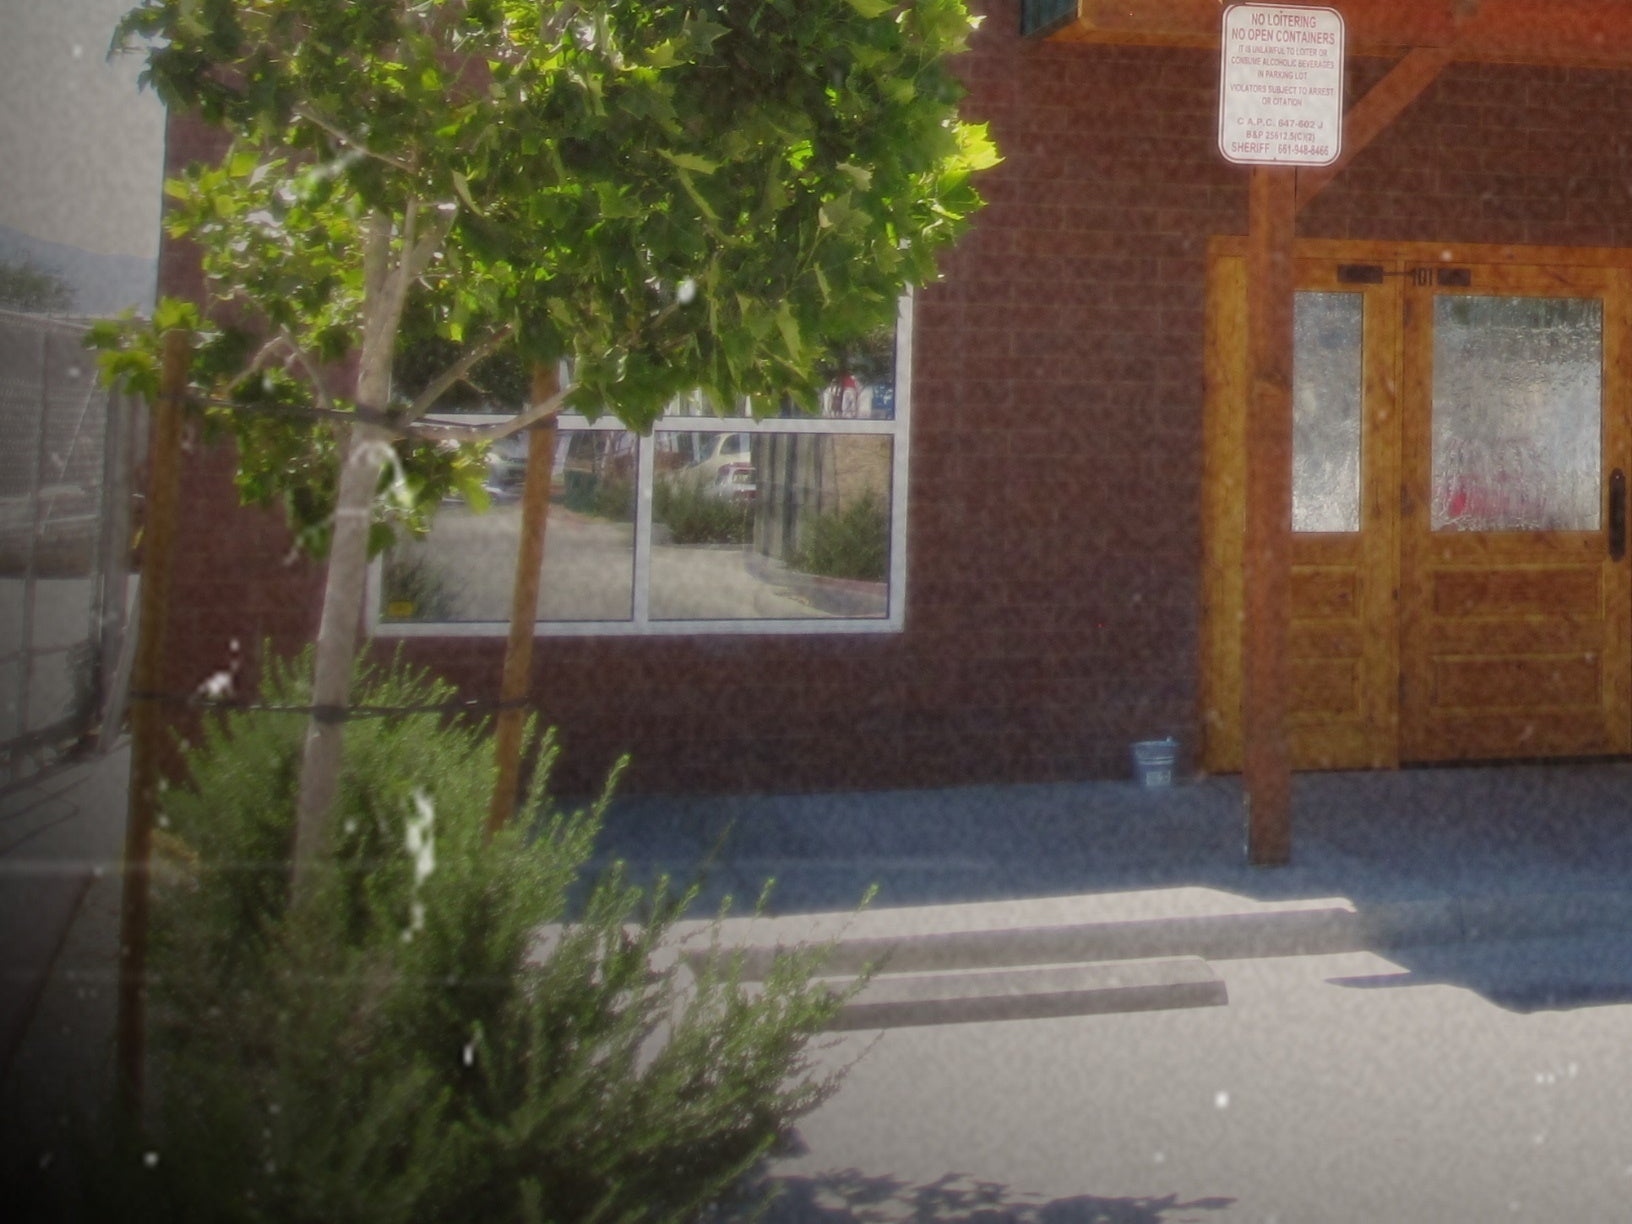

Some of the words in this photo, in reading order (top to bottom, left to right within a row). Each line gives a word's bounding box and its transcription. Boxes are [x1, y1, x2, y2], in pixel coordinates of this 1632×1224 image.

[1251, 13, 1265, 26] NO
[1268, 14, 1317, 28] LOITERING
[1231, 28, 1246, 40] NO
[1248, 28, 1274, 41] OPEN
[1276, 30, 1335, 45] CONTAINERS
[1252, 46, 1285, 55] UNLAWFUL
[1286, 47, 1295, 55] TO
[1296, 47, 1317, 56] LOITER
[1319, 49, 1328, 57] OR
[1231, 56, 1261, 65] CONSUME
[1262, 57, 1296, 67] ALCOHOLIC
[1298, 59, 1334, 69] BEVERAGES
[1257, 70, 1264, 78] IN
[1265, 70, 1294, 79] PARKING
[1295, 71, 1307, 80] LOT
[1230, 83, 1266, 93] VIOLATORS
[1268, 85, 1297, 95] SUBJECT
[1298, 86, 1307, 95] TO
[1308, 87, 1334, 96] ARREST
[1261, 96, 1271, 105] OR
[1272, 97, 1303, 106] CITATION
[1231, 141, 1270, 153] SHERIFF
